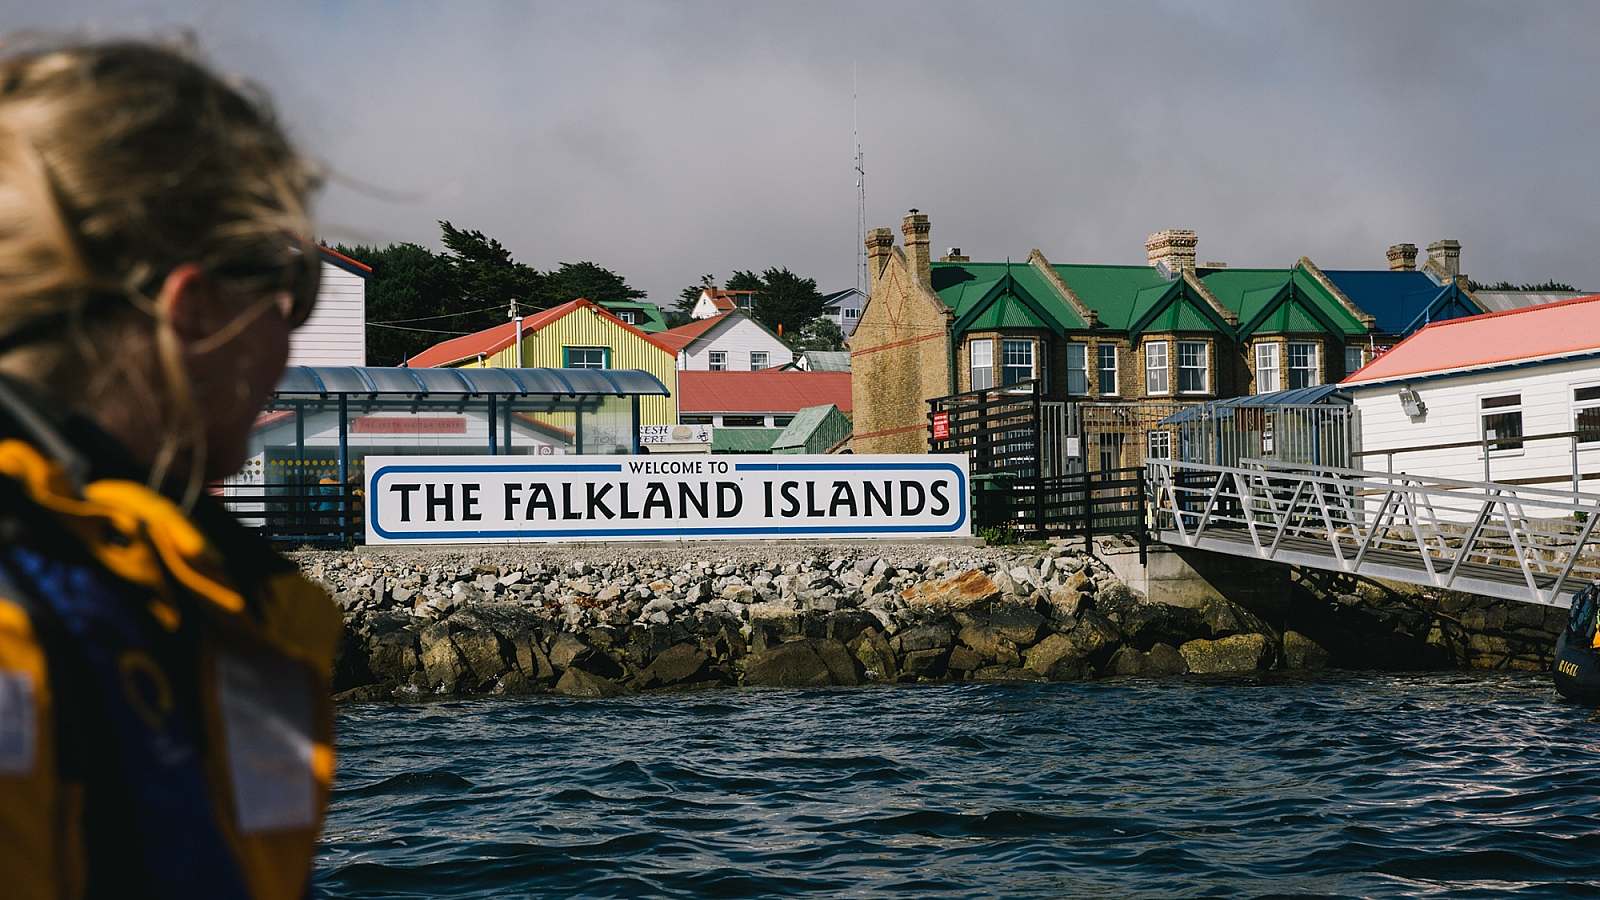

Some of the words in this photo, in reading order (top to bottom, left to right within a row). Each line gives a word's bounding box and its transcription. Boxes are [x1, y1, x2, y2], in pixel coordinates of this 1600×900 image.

[628, 461, 702, 475] WELCOME
[708, 461, 729, 475] TO
[390, 483, 482, 522] THE
[504, 480, 743, 521] FALKLAND
[764, 479, 950, 518] ISLANDS
